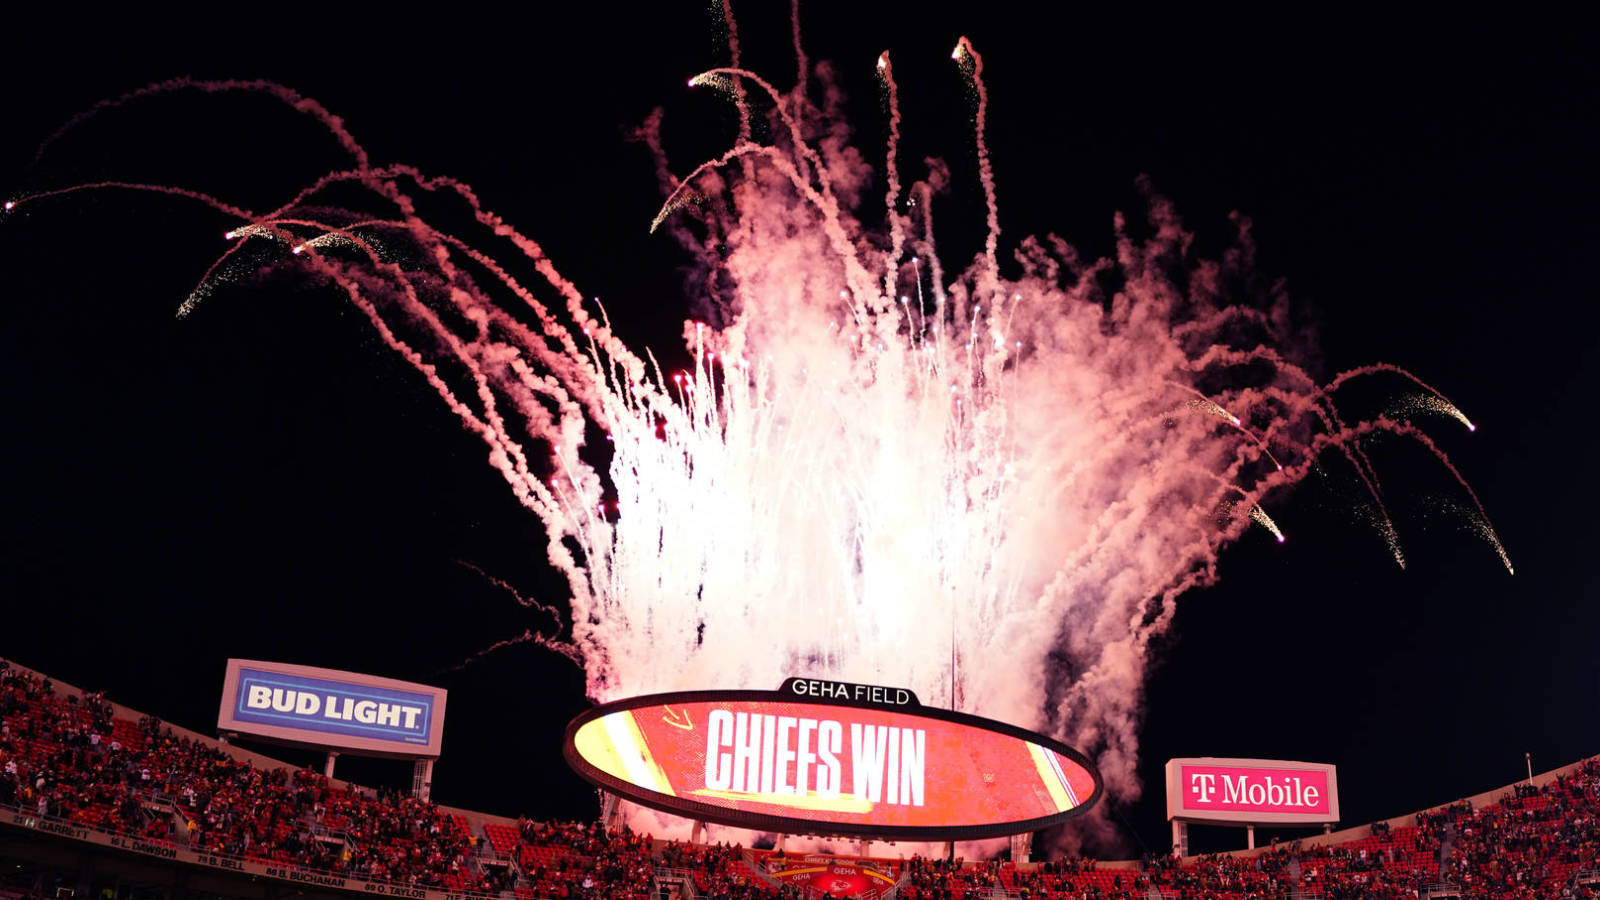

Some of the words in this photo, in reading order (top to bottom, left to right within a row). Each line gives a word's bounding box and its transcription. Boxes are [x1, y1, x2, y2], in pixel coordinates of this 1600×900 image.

[247, 685, 320, 716] BUD
[792, 679, 850, 700] GEHA
[855, 685, 910, 706] FIELD
[704, 709, 843, 799] CHIEFS
[851, 722, 926, 807] WIN
[1220, 774, 1319, 807] Mobile
[38, 820, 89, 840] GARRETT
[132, 840, 177, 859] DAWSON
[289, 871, 346, 887] BUCHANAN
[792, 873, 811, 881] GEHA
[834, 866, 857, 876] GEHA
[389, 886, 426, 899] TAYLOR
